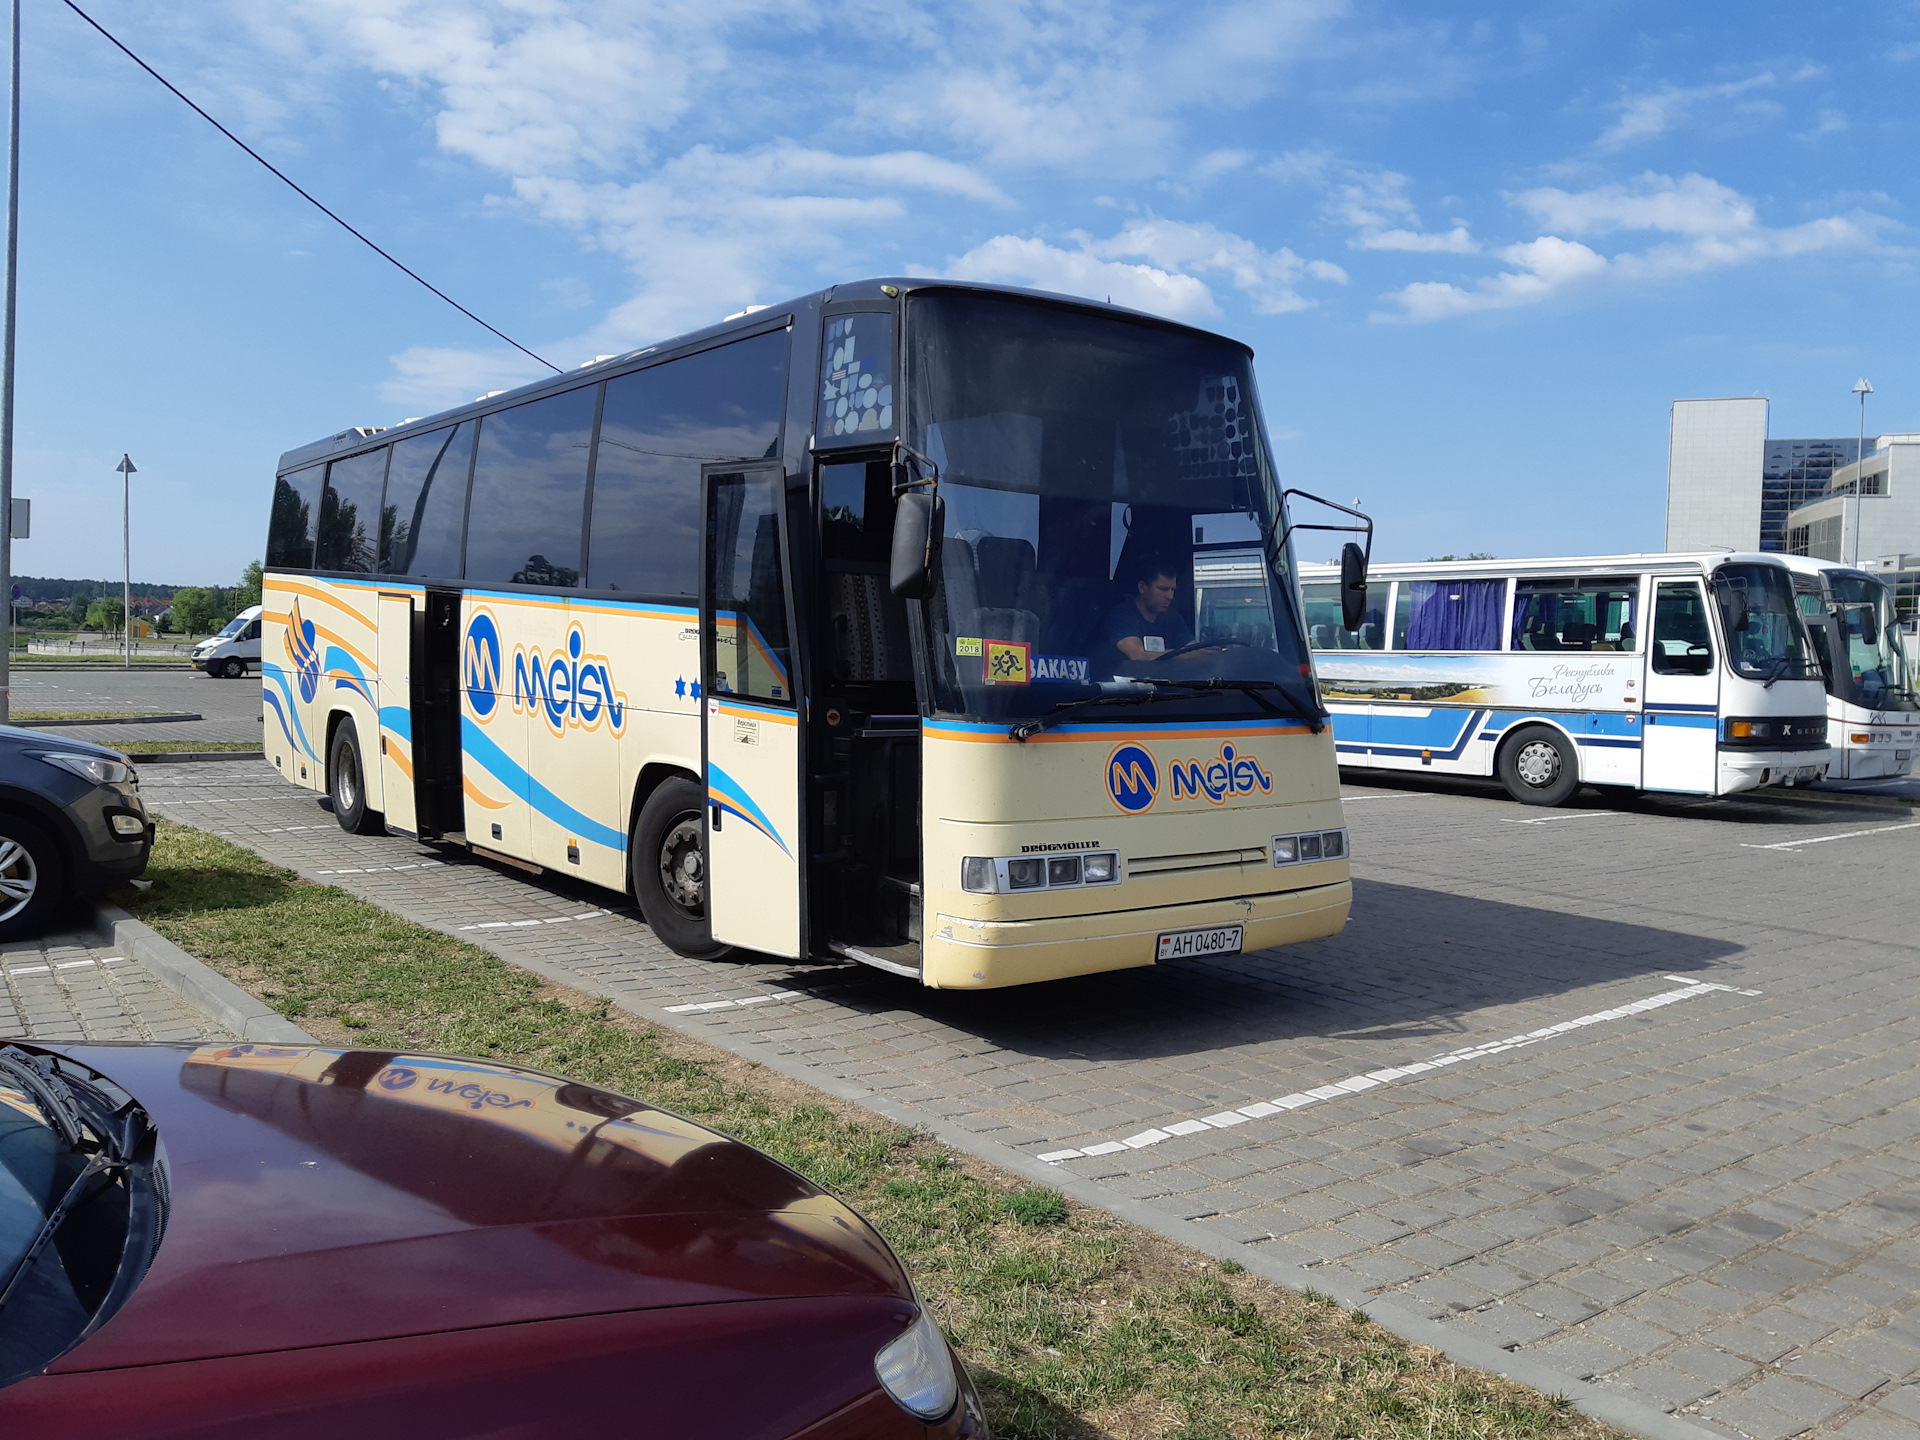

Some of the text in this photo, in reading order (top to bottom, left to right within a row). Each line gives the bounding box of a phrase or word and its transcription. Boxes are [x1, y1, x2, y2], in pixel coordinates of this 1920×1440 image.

[959, 645, 980, 653] 2018
[1528, 676, 1603, 703] Беларусь
[1021, 840, 1101, 853] DRÖGMÖLLER
[1160, 948, 1168, 957] BY
